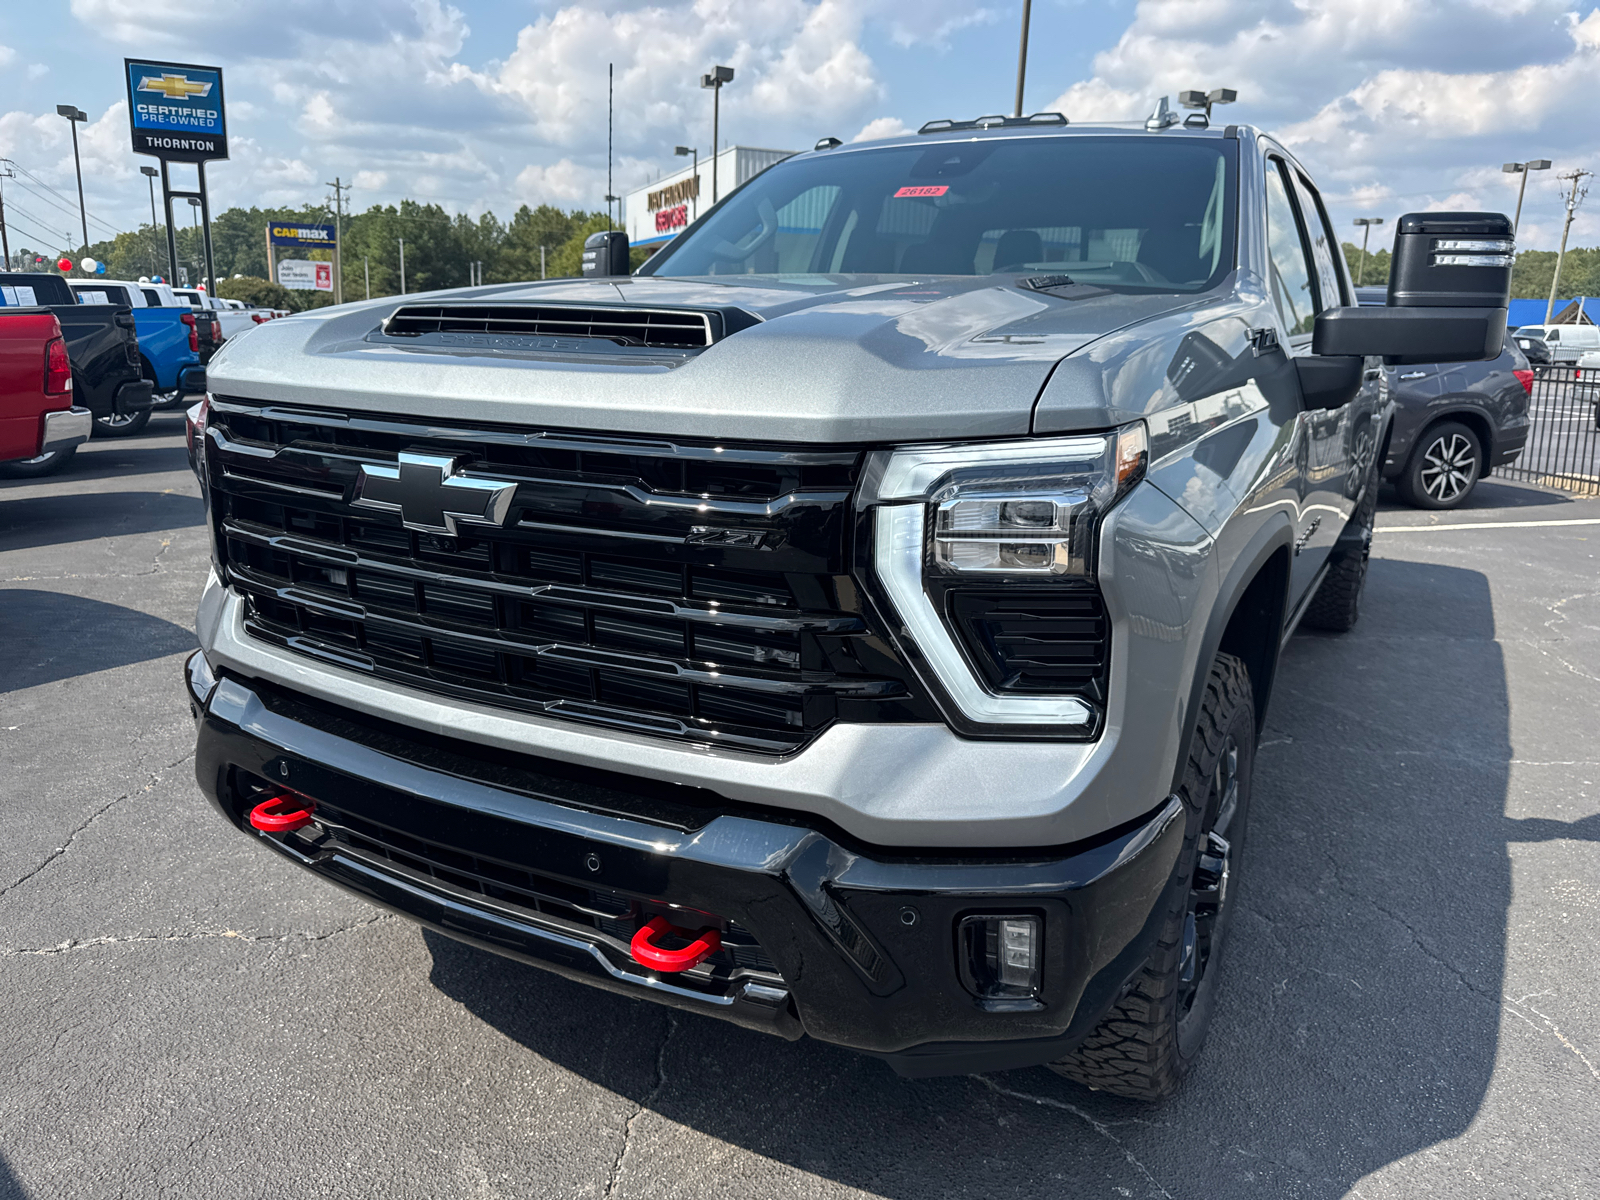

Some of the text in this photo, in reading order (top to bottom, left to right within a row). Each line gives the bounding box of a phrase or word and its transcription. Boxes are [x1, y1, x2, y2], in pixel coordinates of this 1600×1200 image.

[137, 104, 218, 119] CERTIFIED
[141, 113, 215, 127] PRE-OWNED
[145, 136, 215, 151] THORNTON
[901, 187, 940, 196] 26182
[439, 335, 590, 350] CHEVROLET
